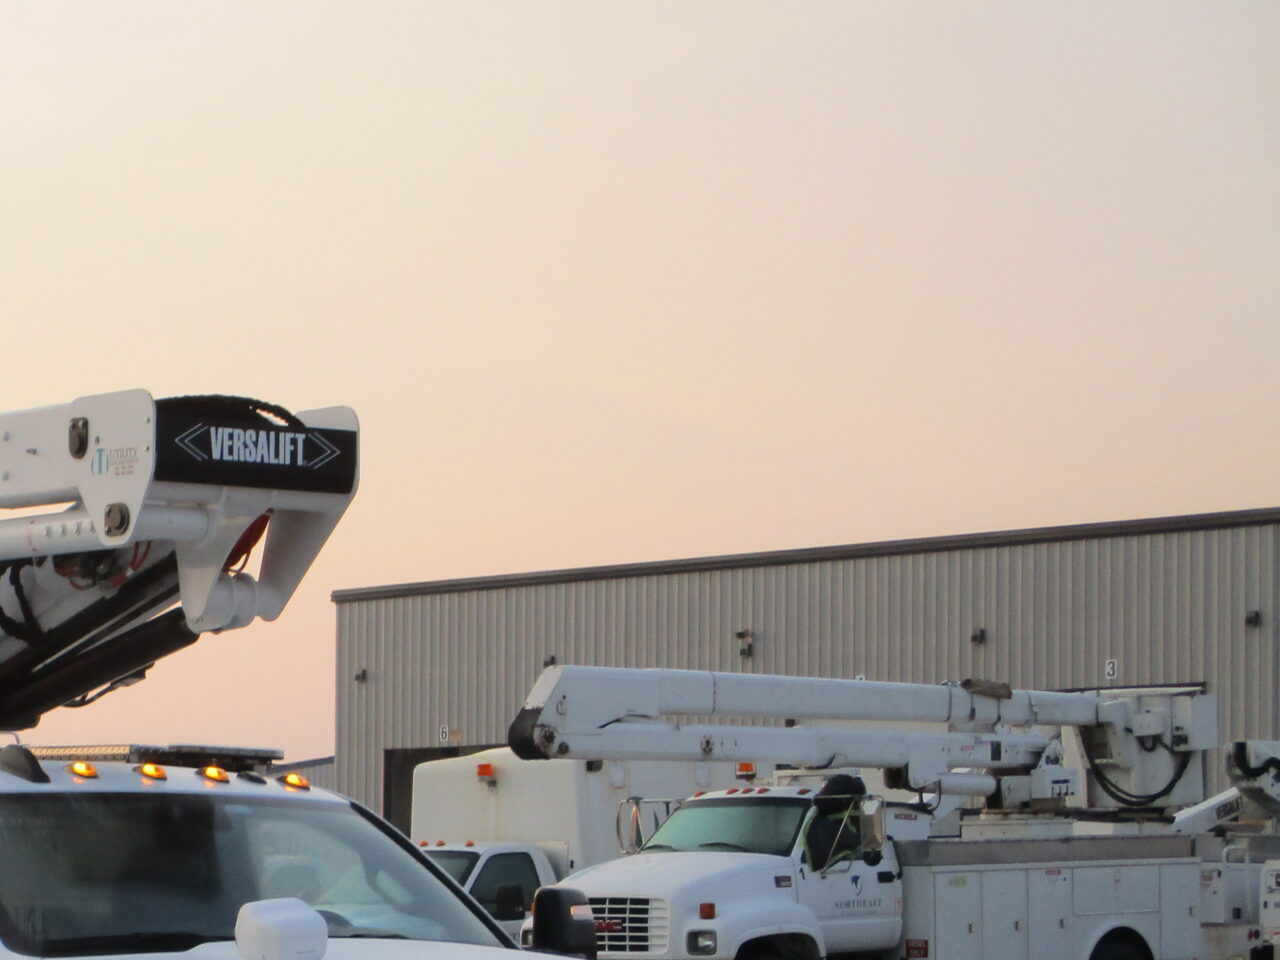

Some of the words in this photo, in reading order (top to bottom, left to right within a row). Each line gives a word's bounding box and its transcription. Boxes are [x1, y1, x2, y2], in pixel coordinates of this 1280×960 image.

[209, 426, 306, 466] VERSALIFT
[1106, 660, 1116, 678] 3
[441, 726, 448, 740] 6
